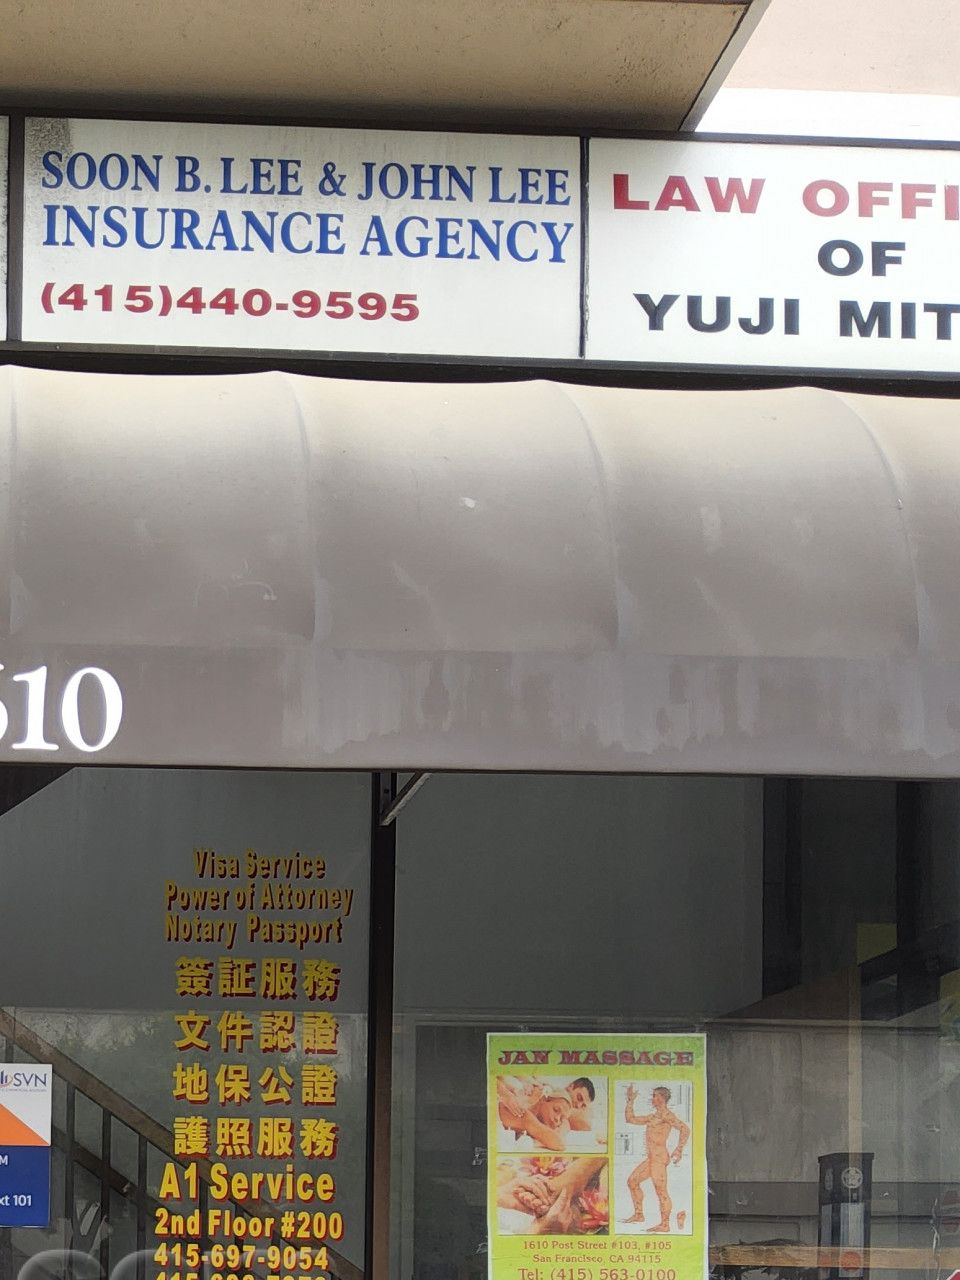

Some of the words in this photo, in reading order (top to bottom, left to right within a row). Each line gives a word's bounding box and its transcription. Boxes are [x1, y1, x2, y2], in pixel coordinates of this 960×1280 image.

[41, 151, 163, 192] SOON
[319, 162, 346, 197] &
[358, 162, 476, 202] JOHN
[488, 166, 571, 205] LEE
[613, 174, 766, 214] LAW
[802, 179, 960, 220] OFFI
[42, 204, 346, 255] INSURANCE
[360, 215, 574, 263] AGENCY
[817, 239, 906, 277] OF
[41, 282, 420, 321] (415)440-9595
[633, 293, 800, 335] YUJI
[839, 300, 960, 340] MIT
[193, 848, 240, 878] Visa
[245, 849, 326, 879] Service
[164, 880, 230, 911] Power
[237, 882, 255, 910] of
[261, 882, 353, 916] Attorney
[164, 913, 237, 950] Notary
[247, 914, 343, 950] Passport
[174, 1010, 339, 1054] 文件認證
[498, 1050, 552, 1065] JAN
[558, 1050, 694, 1066] MASSAGE
[13, 1073, 47, 1087] SVN
[172, 1062, 338, 1106] 地保公證
[173, 1116, 339, 1160] 護照服務
[13, 1194, 32, 1206] 101
[158, 1162, 200, 1200] A1
[209, 1163, 337, 1203] Service
[155, 1208, 201, 1236] 2nd
[208, 1209, 275, 1238] Floor
[281, 1210, 344, 1241] #200
[154, 1243, 330, 1271] 415-697-9054
[523, 1240, 548, 1249] 1610
[552, 1240, 573, 1249] Post
[577, 1240, 608, 1249] Street
[645, 1241, 672, 1250] #105
[533, 1254, 551, 1263] San
[609, 1255, 624, 1263] CA
[628, 1255, 661, 1264] 94115
[518, 1268, 543, 1280] Tel:
